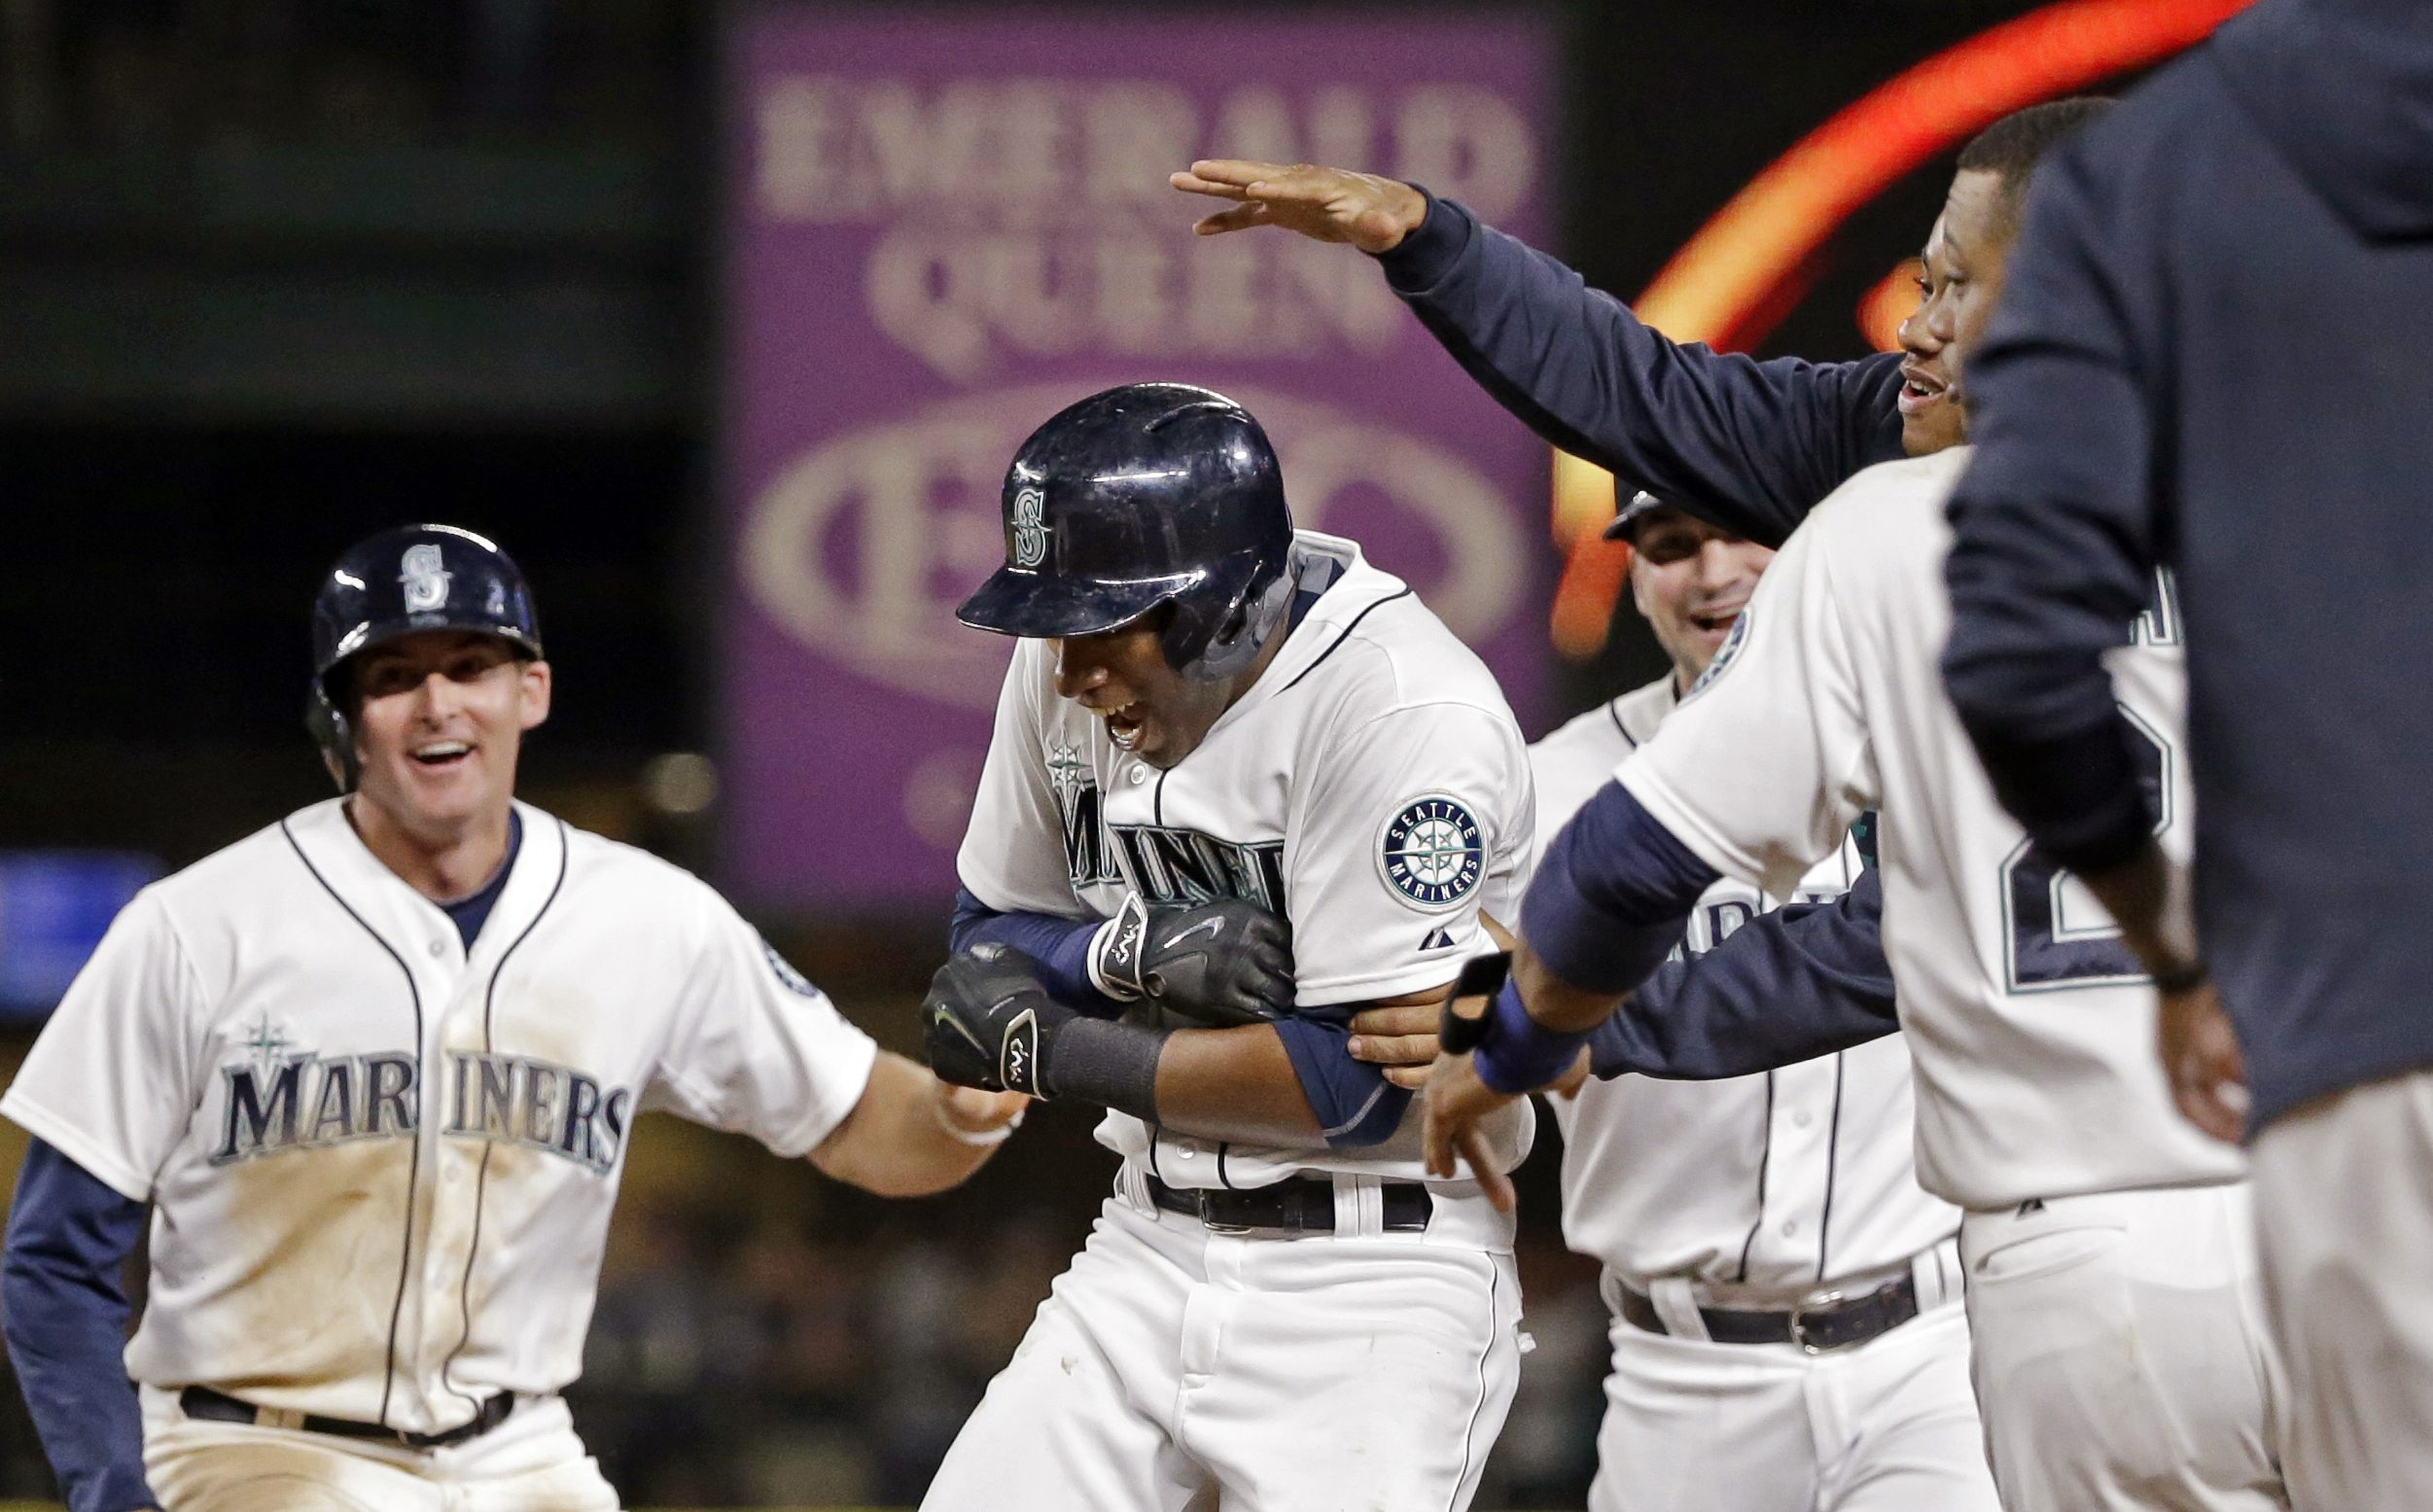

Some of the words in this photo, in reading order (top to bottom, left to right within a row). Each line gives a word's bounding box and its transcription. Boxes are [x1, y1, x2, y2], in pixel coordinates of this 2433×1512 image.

[1391, 802, 1476, 840] SEATTLE
[1390, 859, 1478, 900] MARINERS
[208, 1049, 628, 1174] MARINERS
